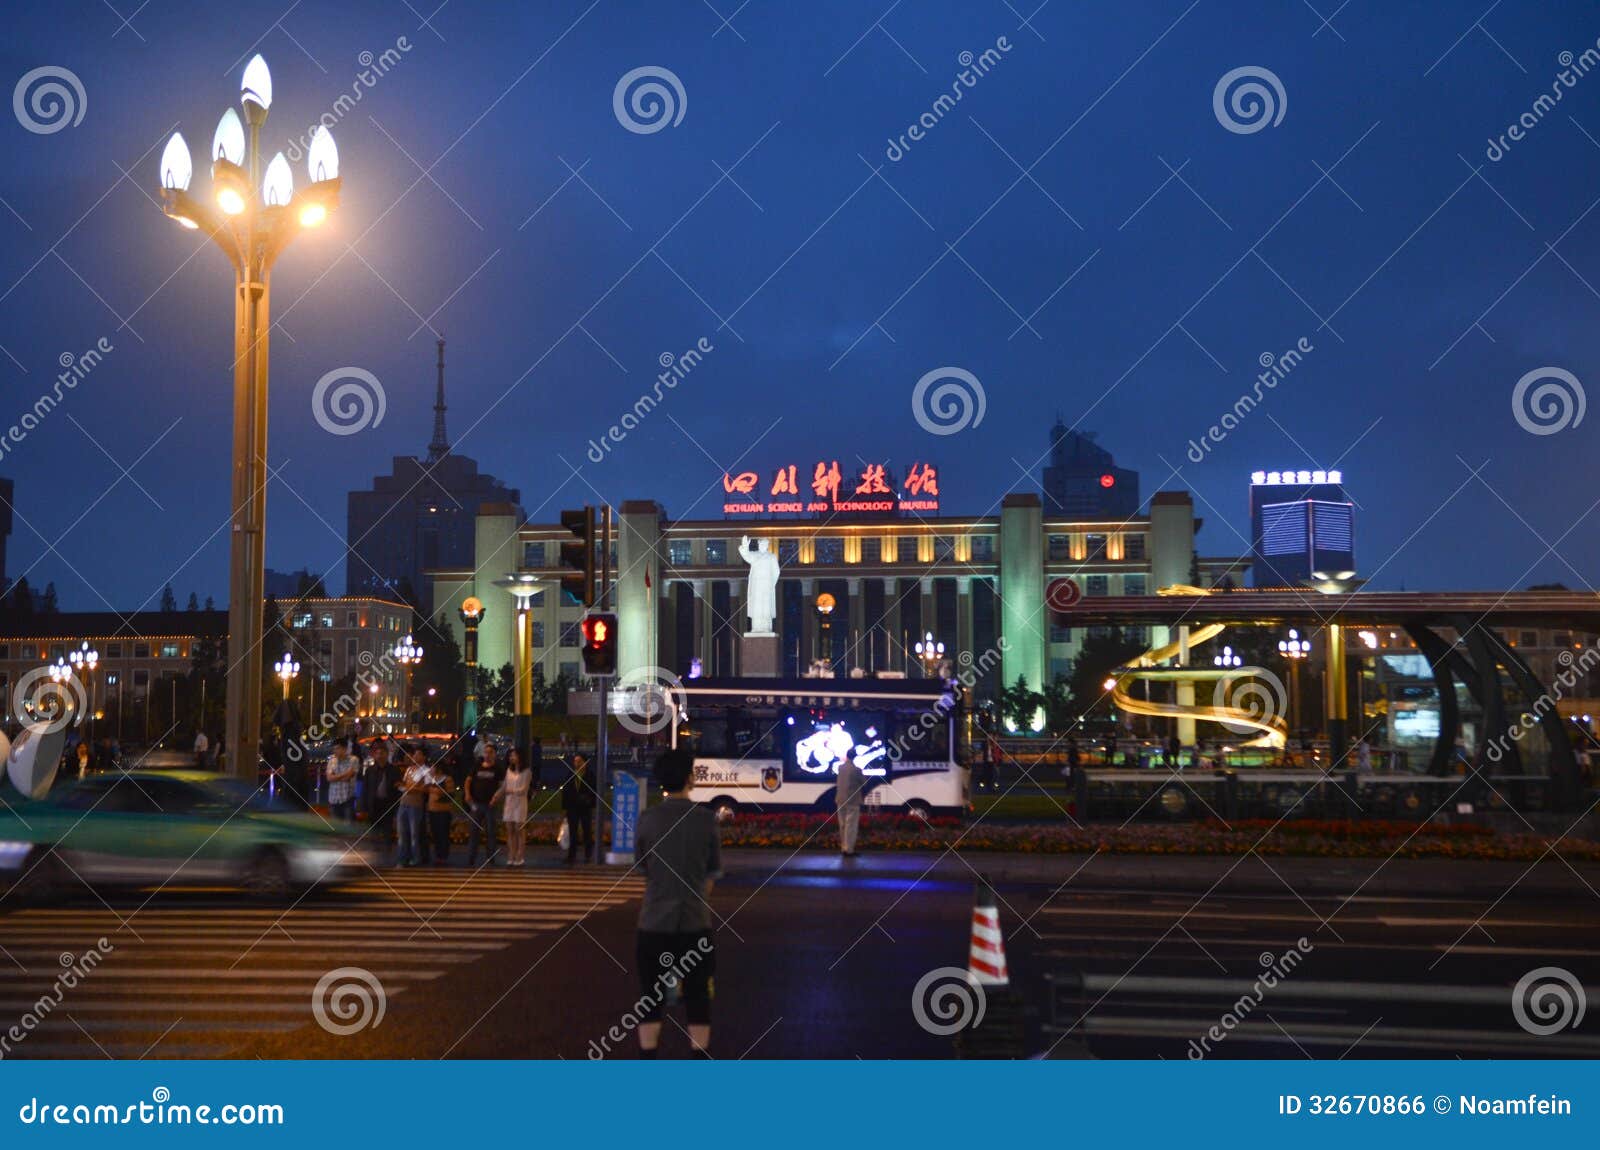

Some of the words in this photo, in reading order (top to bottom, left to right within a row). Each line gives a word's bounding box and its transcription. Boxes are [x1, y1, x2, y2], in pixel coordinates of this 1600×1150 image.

[723, 461, 939, 503] 四川科技馆
[724, 503, 764, 513] SICHUAN
[767, 502, 803, 513] SCIENCE
[807, 502, 829, 512] AND
[833, 501, 893, 512] TECHNOLOGY
[899, 501, 939, 511] MUSEUM
[710, 772, 739, 782] POLICE
